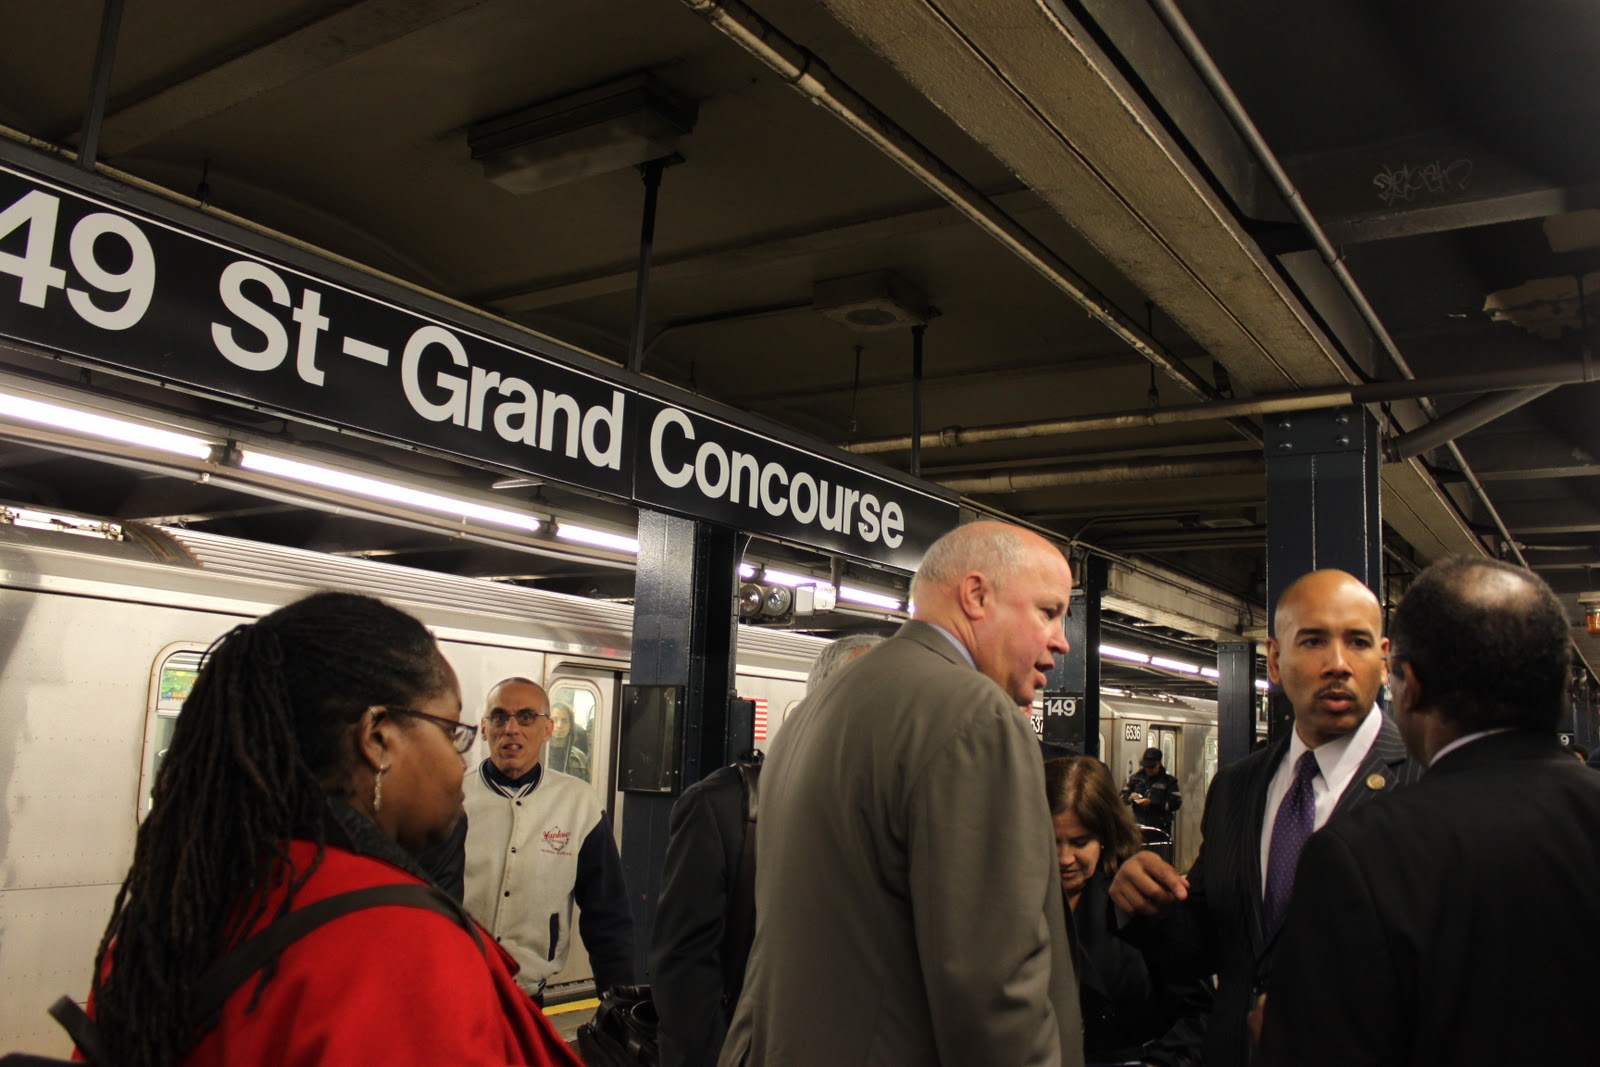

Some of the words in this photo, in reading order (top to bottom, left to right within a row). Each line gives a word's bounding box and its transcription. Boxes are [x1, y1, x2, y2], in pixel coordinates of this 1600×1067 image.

[0, 190, 155, 330] 49
[649, 406, 906, 549] Concourse
[1045, 699, 1076, 717] 149
[1126, 725, 1141, 740] 6536
